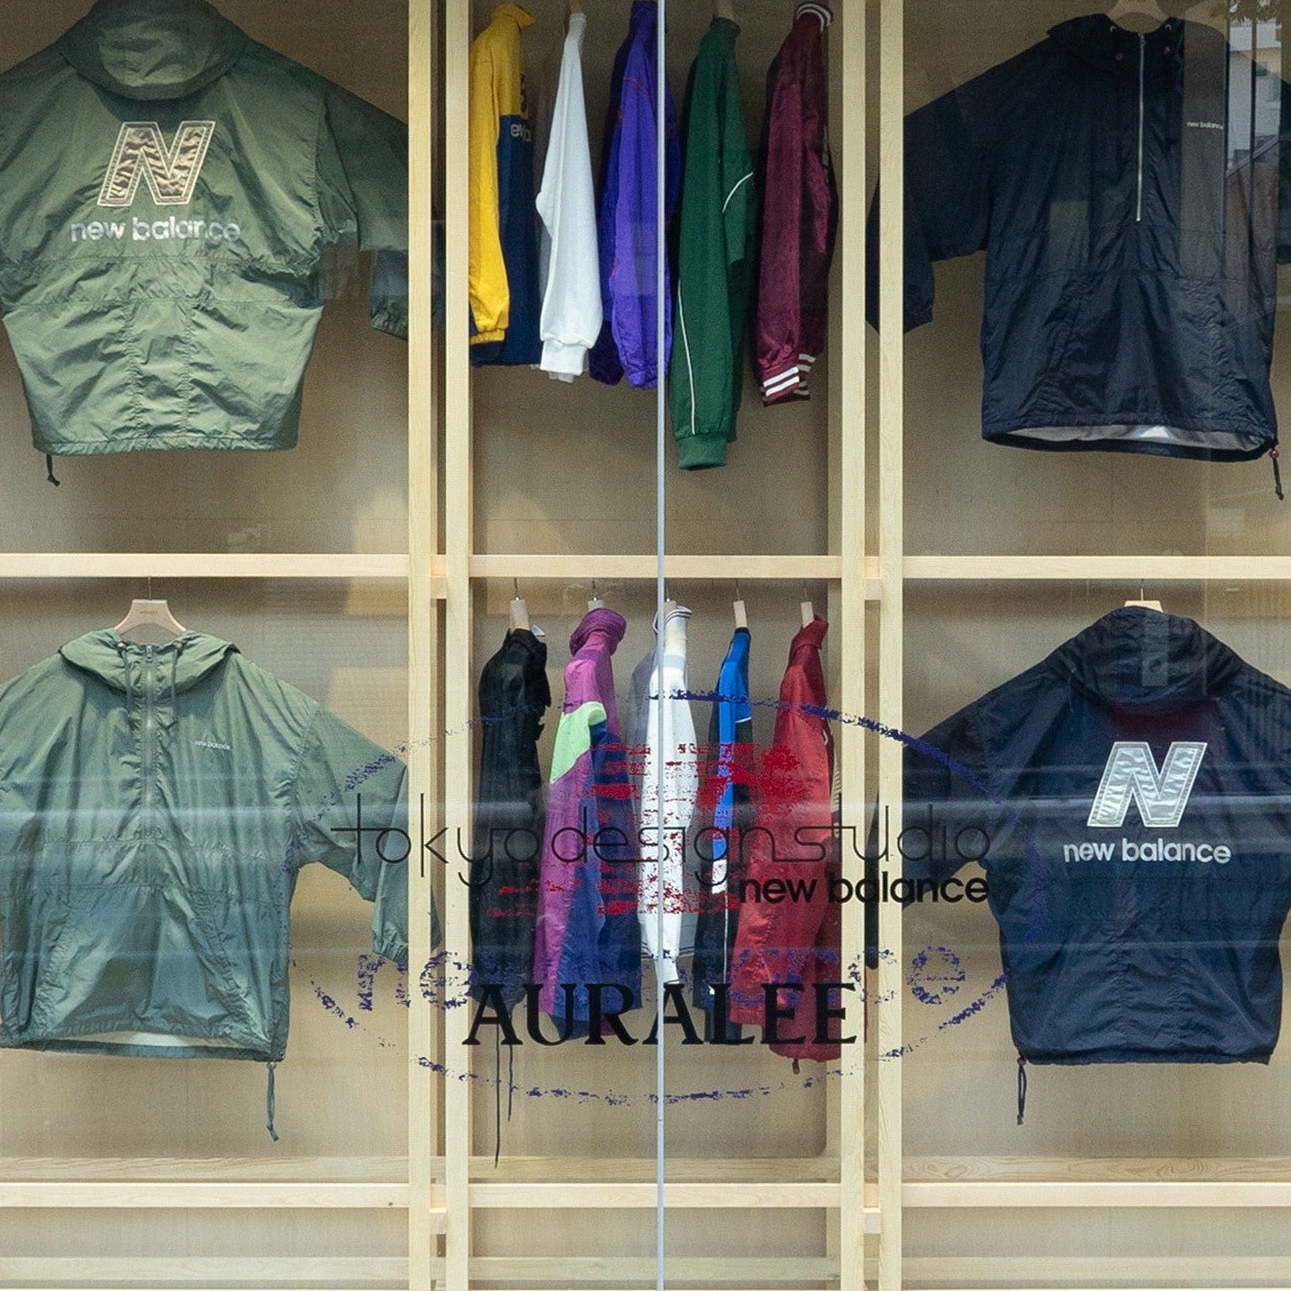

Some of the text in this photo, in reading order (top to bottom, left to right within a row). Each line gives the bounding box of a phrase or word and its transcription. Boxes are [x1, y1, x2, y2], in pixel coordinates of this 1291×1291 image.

[97, 121, 215, 206] N
[71, 215, 241, 243] new balance
[1087, 741, 1208, 827] N
[331, 793, 539, 886] tokyo
[551, 806, 776, 886] design
[794, 793, 990, 862] studio
[1063, 838, 1231, 864] new balance
[739, 870, 989, 904] new balance
[462, 983, 857, 1046] AURALEE
